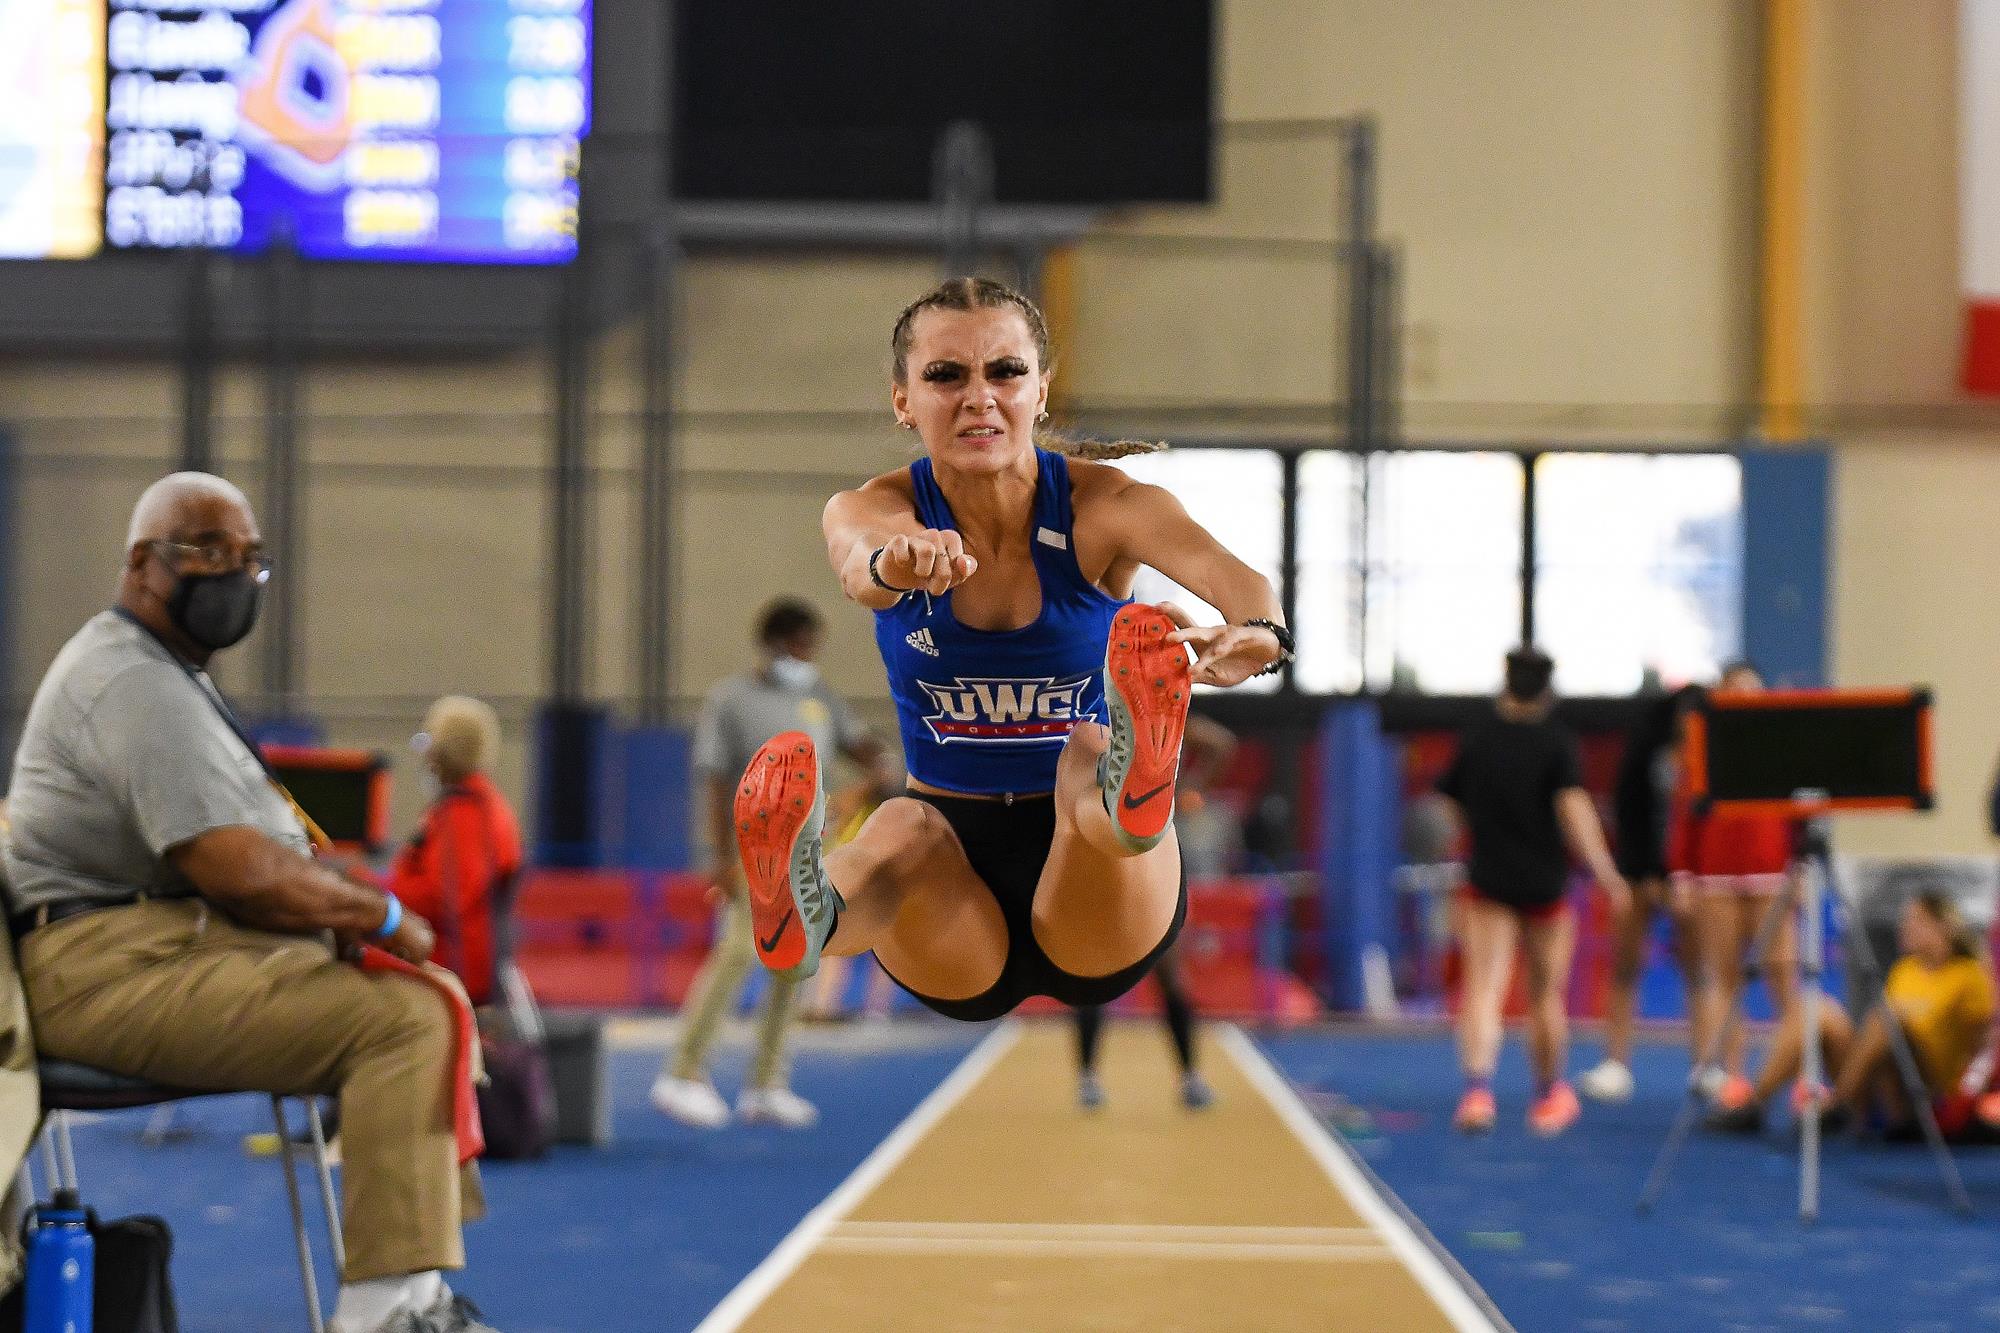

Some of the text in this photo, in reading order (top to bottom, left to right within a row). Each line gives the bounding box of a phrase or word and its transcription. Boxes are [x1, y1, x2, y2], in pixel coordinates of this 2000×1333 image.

[905, 634, 940, 657] adidas
[934, 684, 1073, 722] UWG
[945, 722, 1074, 735] WOLVES
